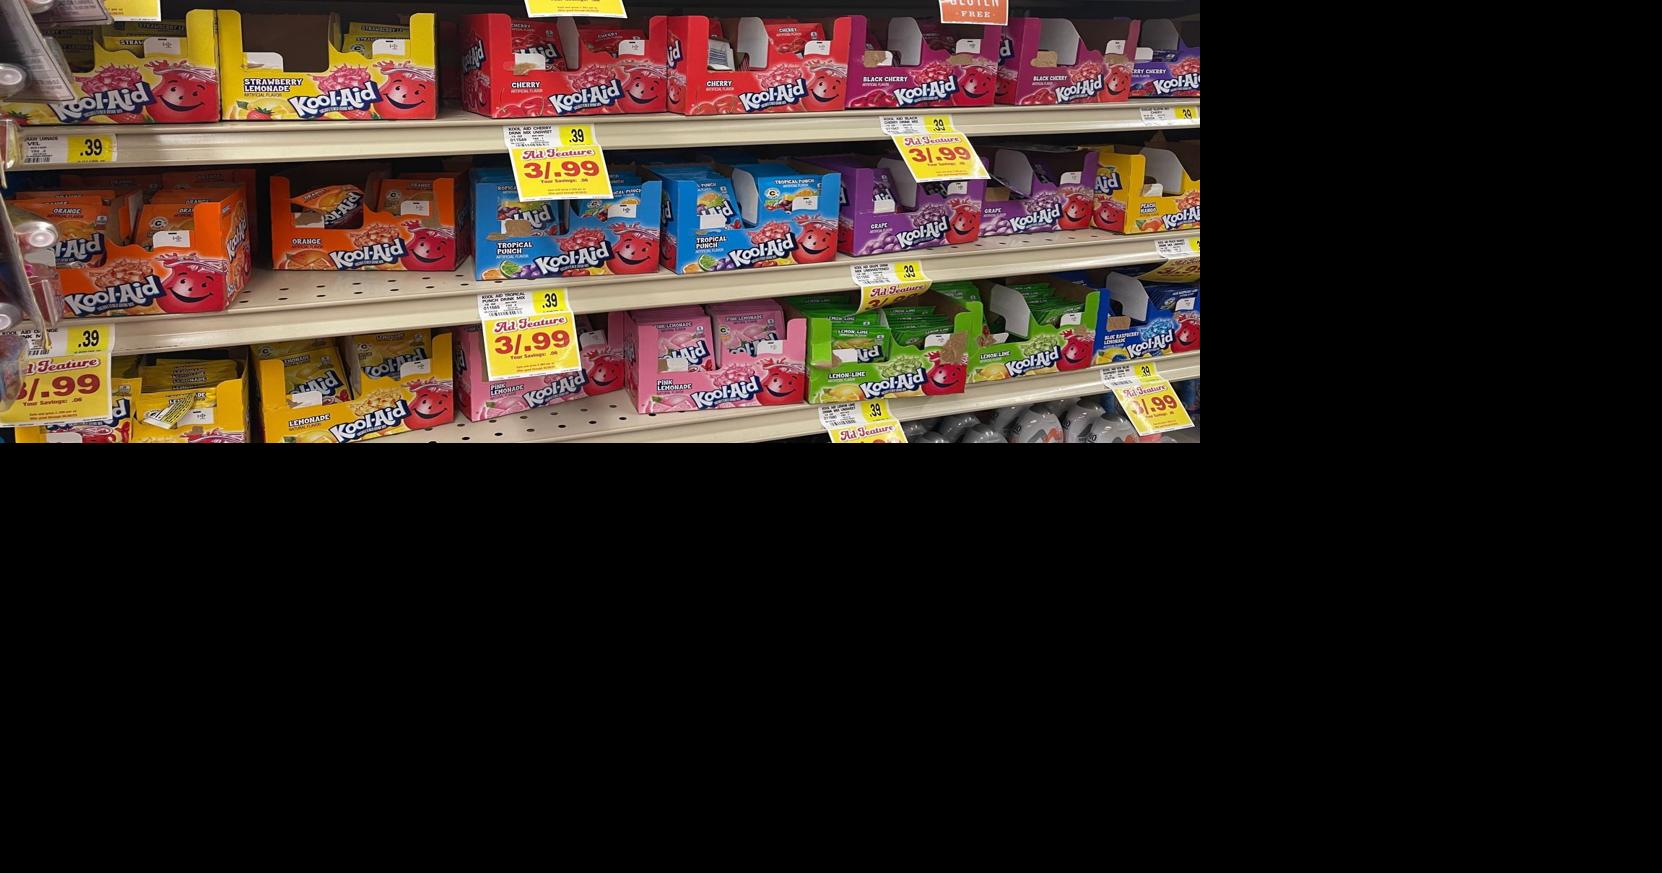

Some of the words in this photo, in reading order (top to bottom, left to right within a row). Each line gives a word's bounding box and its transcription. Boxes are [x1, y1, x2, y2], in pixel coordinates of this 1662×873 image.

[244, 78, 304, 87] STRAWBERRY
[894, 76, 956, 106] Kool-Aid
[1056, 75, 1103, 104] Kool-Aid
[1153, 76, 1200, 95] Kool-Ai
[53, 83, 150, 121] Kool-Aid
[290, 82, 378, 117] Kool-Aid
[550, 81, 621, 114] Kool-Aid
[740, 79, 806, 112] Kool-Aid
[569, 128, 585, 143] .39
[905, 137, 921, 146] Ad
[922, 136, 960, 144] Feature
[80, 138, 103, 156] .39
[522, 150, 544, 160] Ad
[546, 149, 593, 158] Feature
[908, 147, 971, 163] 3/.99
[523, 160, 600, 179] 3/.99
[1010, 205, 1060, 232] Kool-Aid
[1163, 206, 1200, 229] Kool-Ai
[696, 236, 728, 244] TROPICAL
[897, 216, 949, 248] Kool-Aid
[330, 238, 404, 270] Kool-Aid
[536, 242, 610, 275] Kool-Aid
[729, 234, 795, 268] Kool-Aid
[65, 276, 161, 315] Kool-Aid
[542, 292, 558, 308] .39
[870, 287, 887, 297] Ad
[889, 284, 925, 295] Feature
[494, 321, 516, 333] Ad
[518, 317, 565, 329] Feature
[78, 330, 100, 348] .39
[495, 330, 570, 355] 3/.99
[1126, 330, 1174, 358] Kool-Aid
[981, 351, 1011, 360] LEMON-LIME
[1006, 346, 1060, 377] Kool-Aid
[38, 359, 98, 373] Feature
[829, 371, 866, 379] LEMON-LIME
[490, 385, 524, 396] LEMONADE
[523, 373, 586, 408] Kool-Aid
[657, 384, 692, 392] LEMONADE
[691, 376, 760, 408] Kool-Aid
[861, 368, 926, 399] Kool-Aid
[1137, 385, 1167, 395] Feature
[869, 403, 882, 417] .39
[289, 413, 331, 427] LEMONADE
[331, 400, 407, 443] Kool-Aid
[840, 430, 857, 441] Ad
[857, 425, 894, 437] Feature
